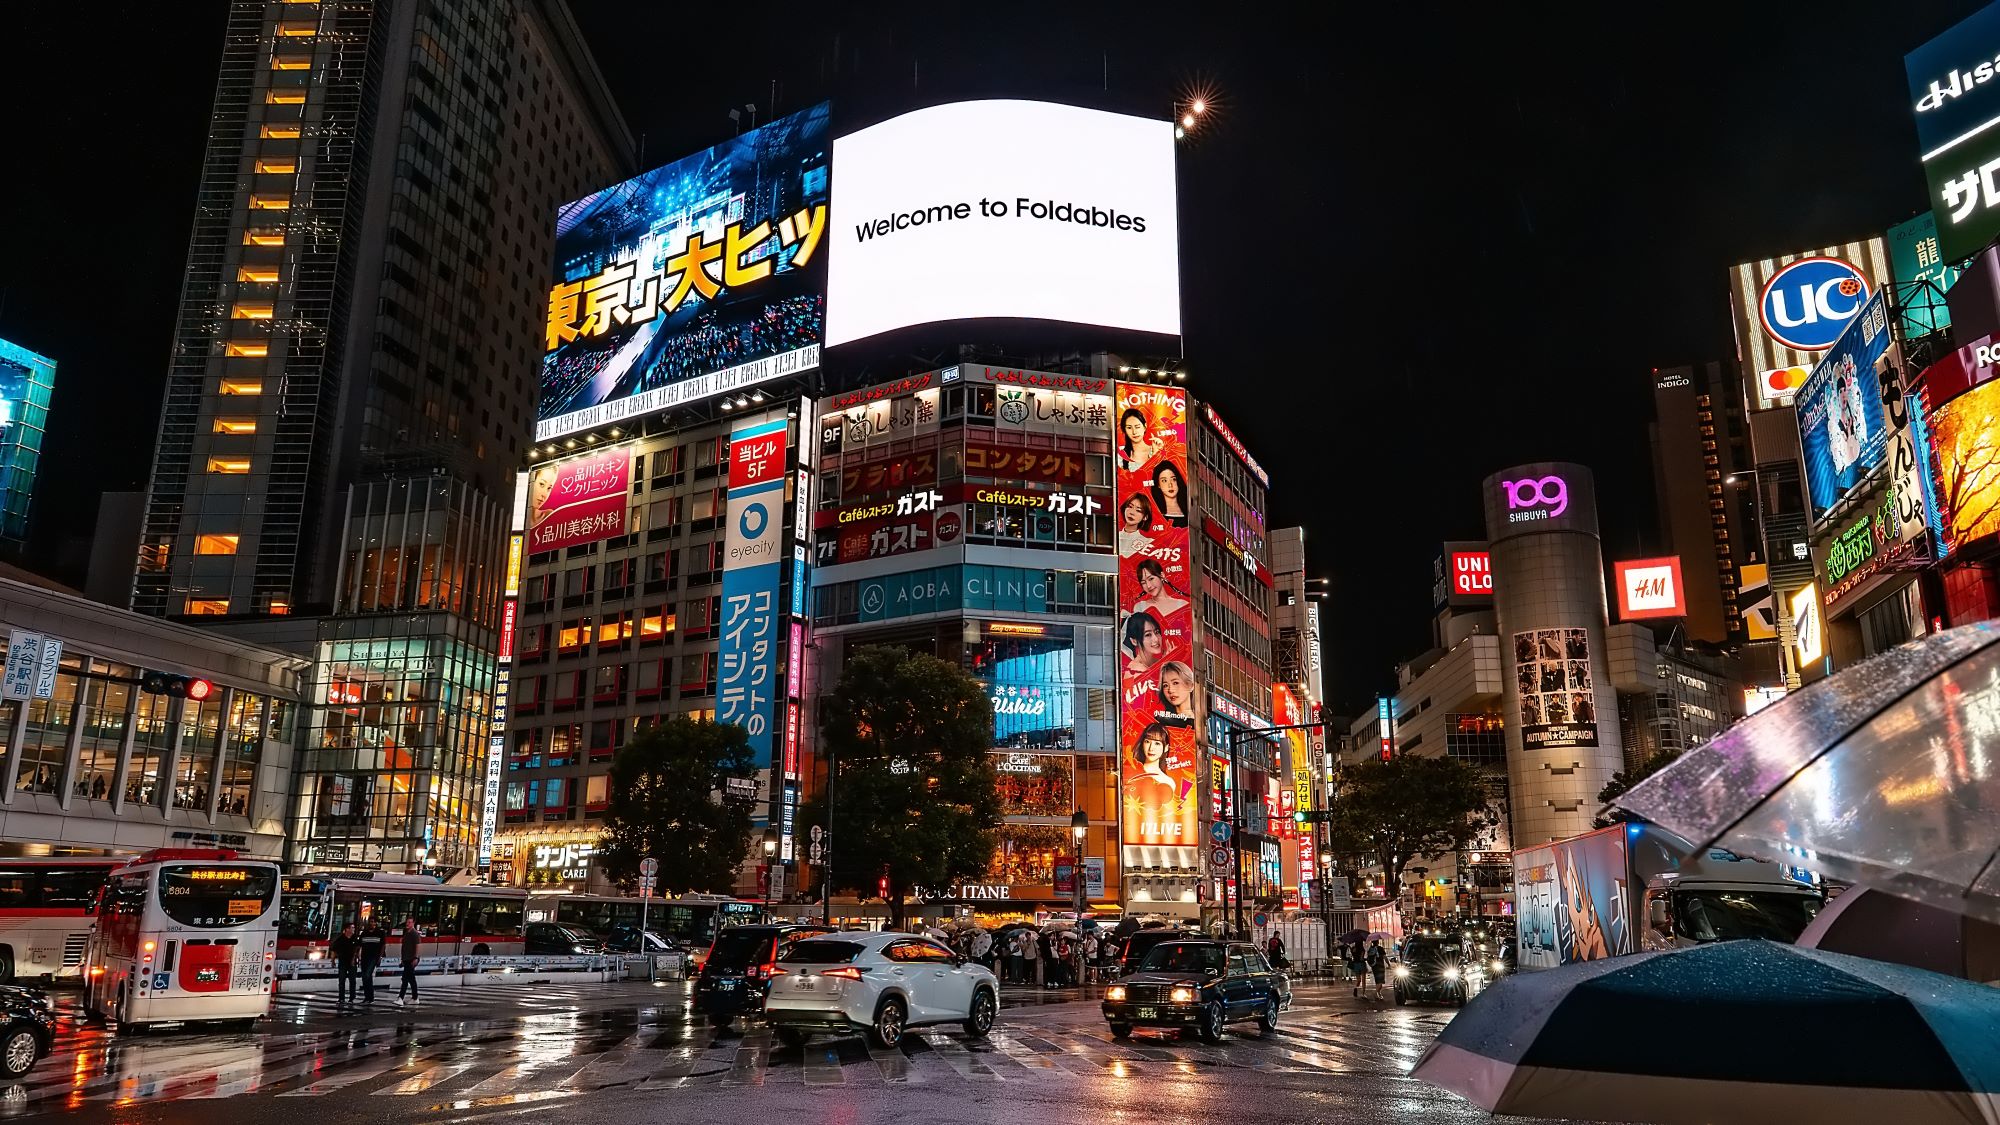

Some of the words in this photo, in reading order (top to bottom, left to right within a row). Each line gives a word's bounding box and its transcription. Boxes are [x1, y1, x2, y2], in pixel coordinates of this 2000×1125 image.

[855, 197, 971, 243] Welcome
[980, 197, 1007, 217] to
[1015, 197, 1146, 233] Foldables
[985, 367, 1107, 393] しゃぶしゃぶバイキング
[1657, 379, 1690, 389] INDIGO
[1036, 399, 1107, 427] しゃぶ葉
[1118, 391, 1186, 413] NOTHING
[876, 401, 934, 432] しゃぶ葉
[823, 427, 841, 443] 9F
[739, 442, 777, 461] 当ビル
[966, 448, 1080, 477] コンタクト
[575, 457, 625, 482] 品川スキン
[747, 460, 767, 479] 5F
[574, 474, 619, 497] クリニック
[1502, 475, 1569, 517] 109
[896, 489, 944, 516] ガスト
[976, 490, 1045, 507] Caféレストラン
[1048, 492, 1102, 515] ガスト
[1509, 509, 1547, 522] SHIBUYA
[542, 510, 620, 544] 品川美容外科
[730, 540, 775, 558] eyecity
[818, 540, 837, 559] 7F
[870, 523, 928, 557] ガスト
[1132, 539, 1181, 562] BEATS
[1457, 557, 1489, 572] UNI
[897, 581, 951, 603] AOBA
[967, 578, 1046, 599] CLINIC
[1459, 574, 1493, 592] QLO
[1635, 577, 1666, 598] H&M
[1308, 607, 1316, 625] BIC
[11, 644, 21, 671] Shibuya
[14, 637, 37, 696] 渋谷駅前
[748, 590, 771, 736] コンタクトの
[38, 641, 58, 697] スクランブル式
[1125, 678, 1159, 704] LIVE
[1527, 732, 1552, 743] AUTUMN
[1559, 730, 1594, 741] CAMPAIGN
[489, 760, 500, 776] 内科
[997, 762, 1042, 773] L'OCCITANE
[485, 779, 498, 814] 産婦人科
[505, 846, 513, 857] 2F
[1260, 841, 1279, 864] LUSH
[237, 951, 261, 962] 渋谷
[237, 964, 259, 976] 美術
[235, 977, 258, 989] 学院
